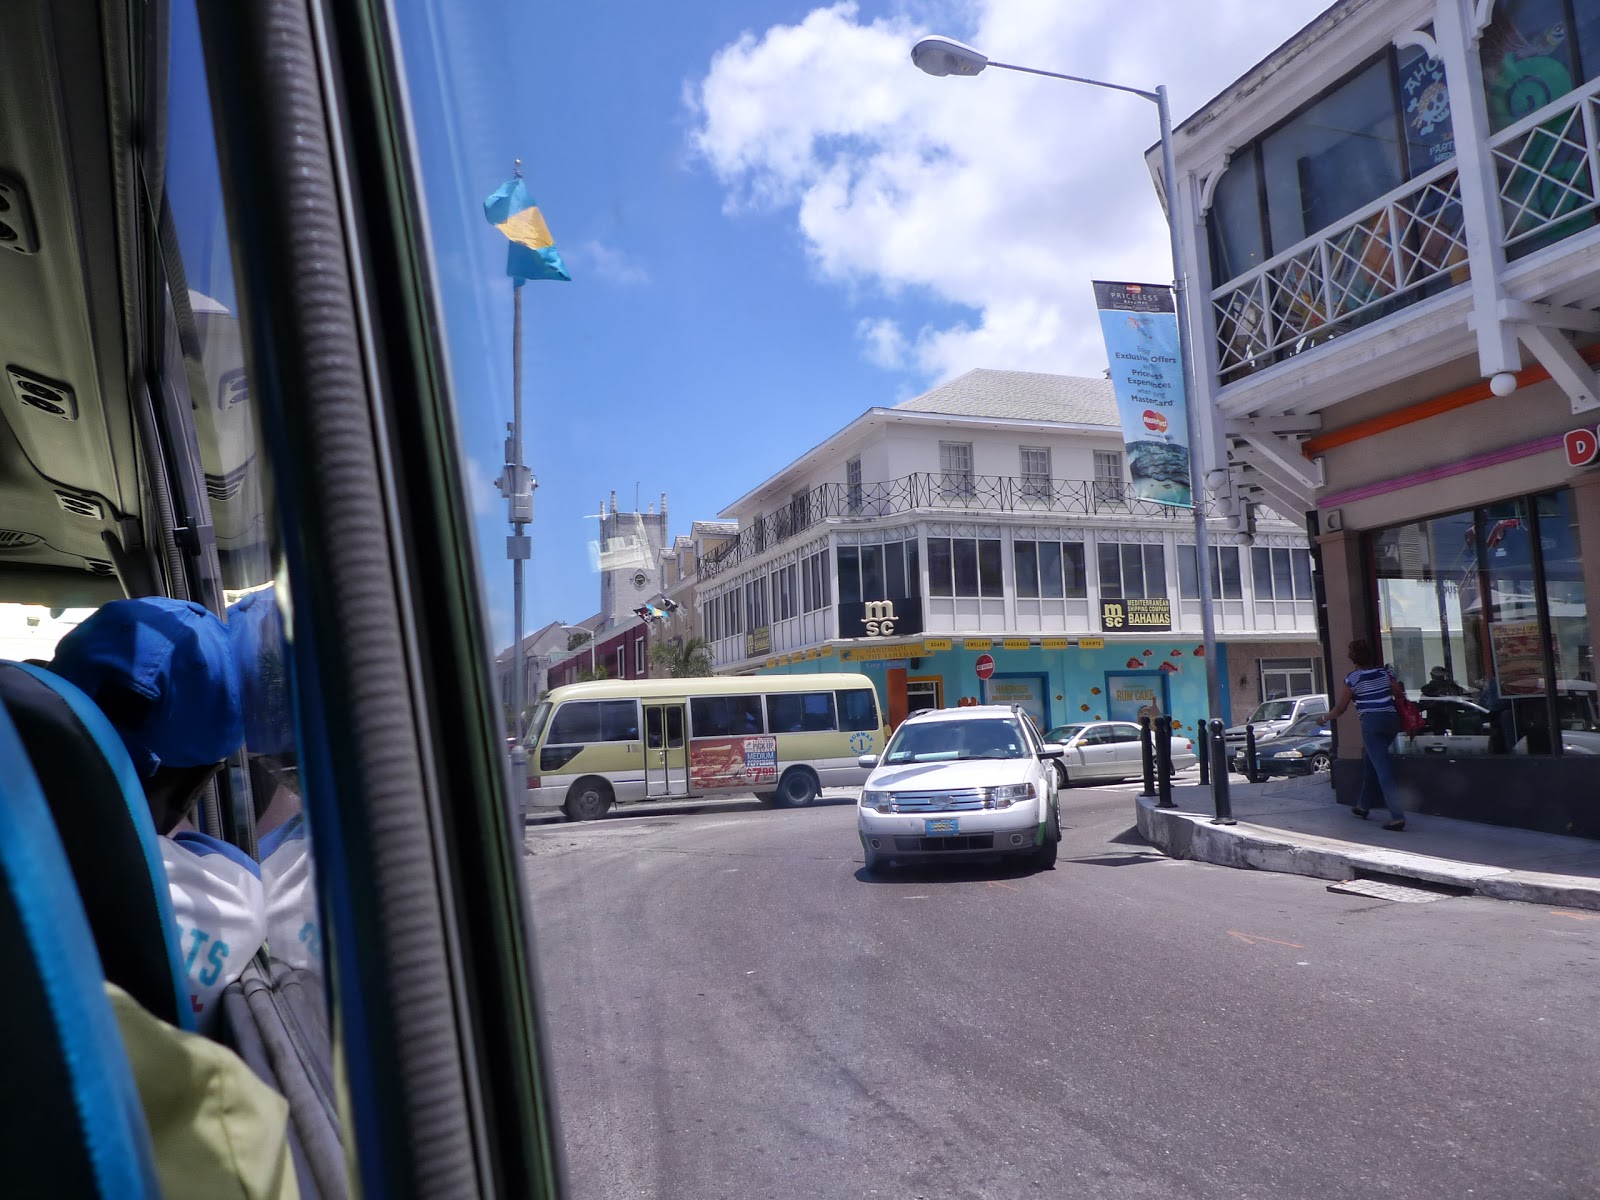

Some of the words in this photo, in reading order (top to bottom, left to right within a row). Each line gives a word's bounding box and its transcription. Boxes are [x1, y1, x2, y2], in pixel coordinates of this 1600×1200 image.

[1404, 53, 1444, 95] AHO
[1429, 140, 1454, 156] PART
[1110, 292, 1159, 302] PRICELESS
[1115, 352, 1149, 362] Exclusive
[1150, 355, 1177, 364] Offers
[1131, 394, 1173, 406] MasterCard
[1128, 613, 1170, 624] BAHAMAS
[866, 645, 907, 654] HANDMADE
[883, 651, 918, 659] BAHAMAS
[1116, 688, 1133, 701] RUM
[1134, 689, 1154, 701] CAKE
[849, 731, 874, 743] SUBWAY
[859, 738, 865, 750] 1
[747, 752, 774, 760] MEDIUM
